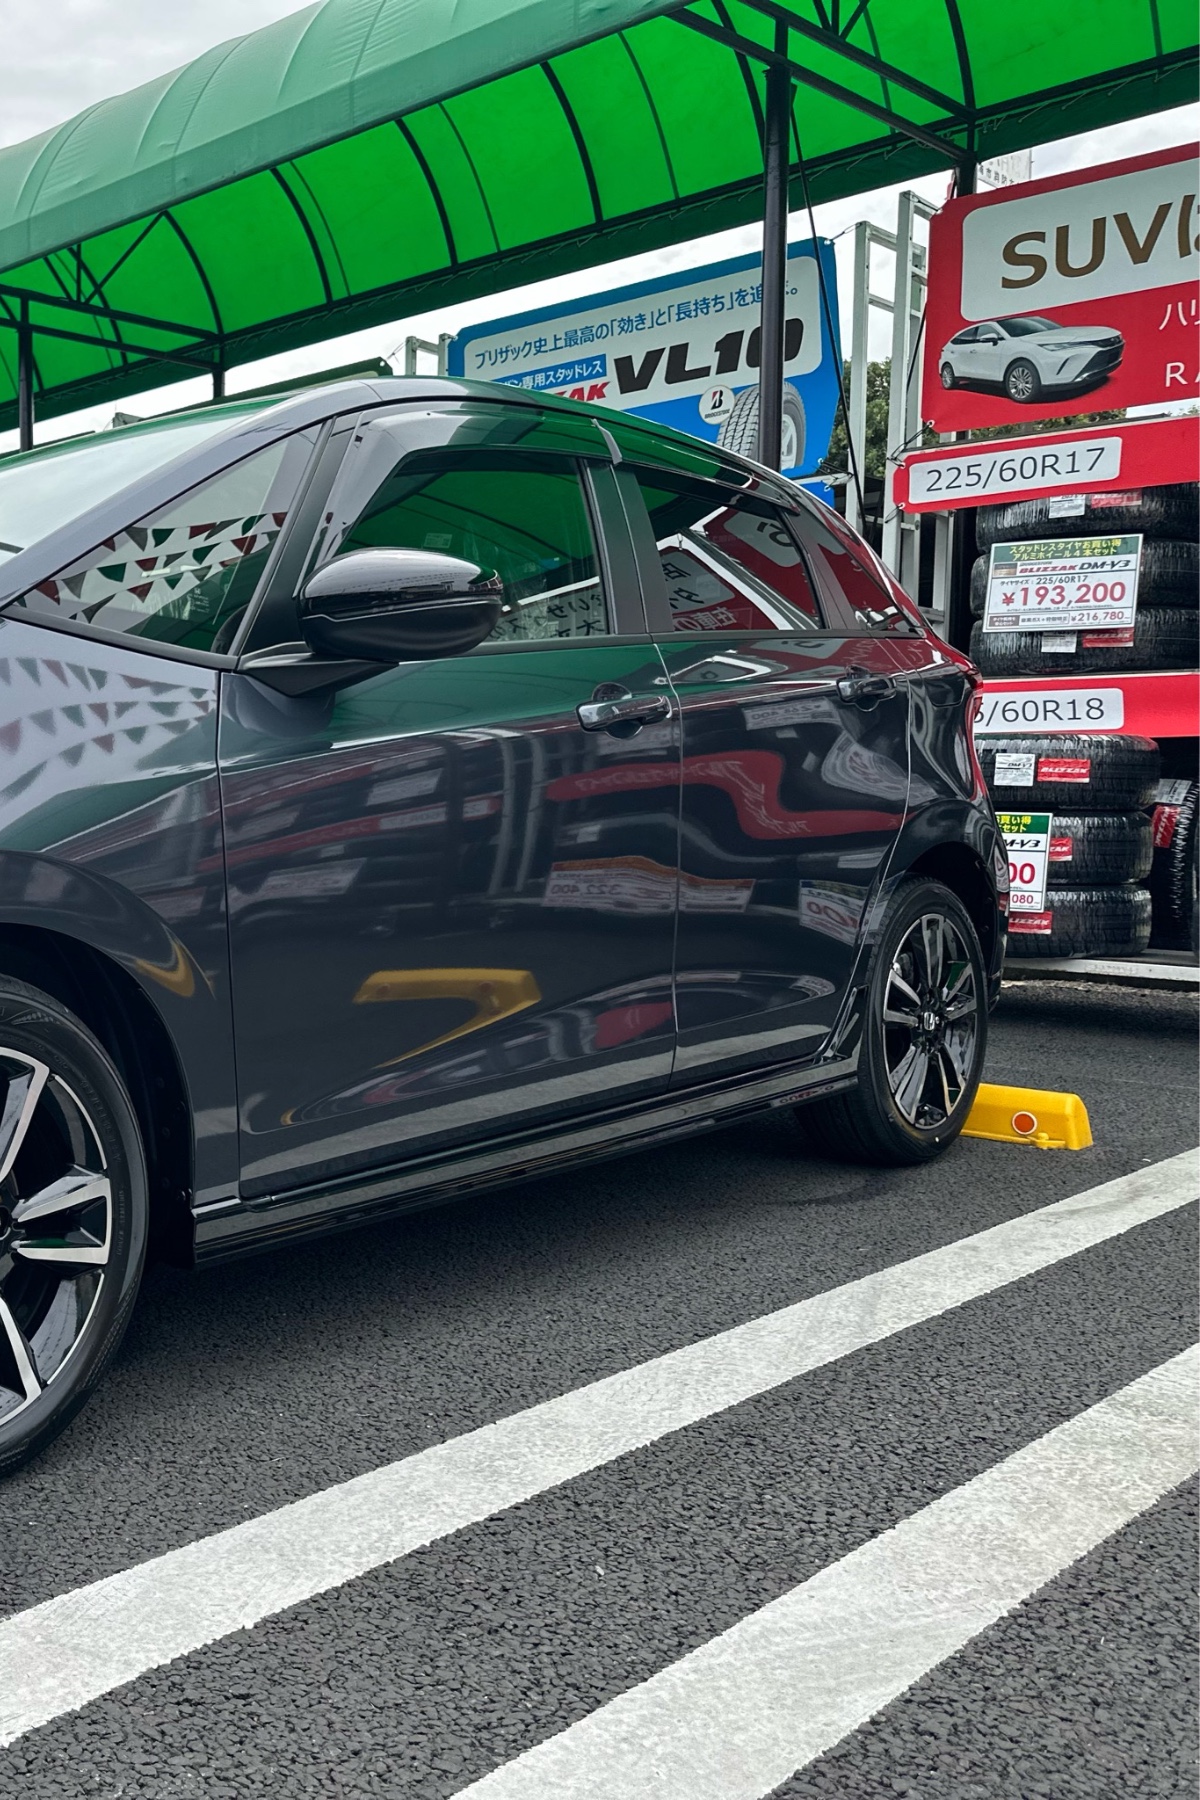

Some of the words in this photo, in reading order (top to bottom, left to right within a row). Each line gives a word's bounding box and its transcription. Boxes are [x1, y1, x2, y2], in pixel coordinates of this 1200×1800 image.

[613, 317, 804, 395] VL10
[926, 447, 1105, 492] 225/60R17
[1018, 564, 1078, 574] BLIZZAK
[1078, 559, 1132, 571] DM-V3
[1035, 575, 1088, 585] 225/60R17
[1002, 581, 1126, 607] ¥193,200
[999, 824, 1027, 833] セット
